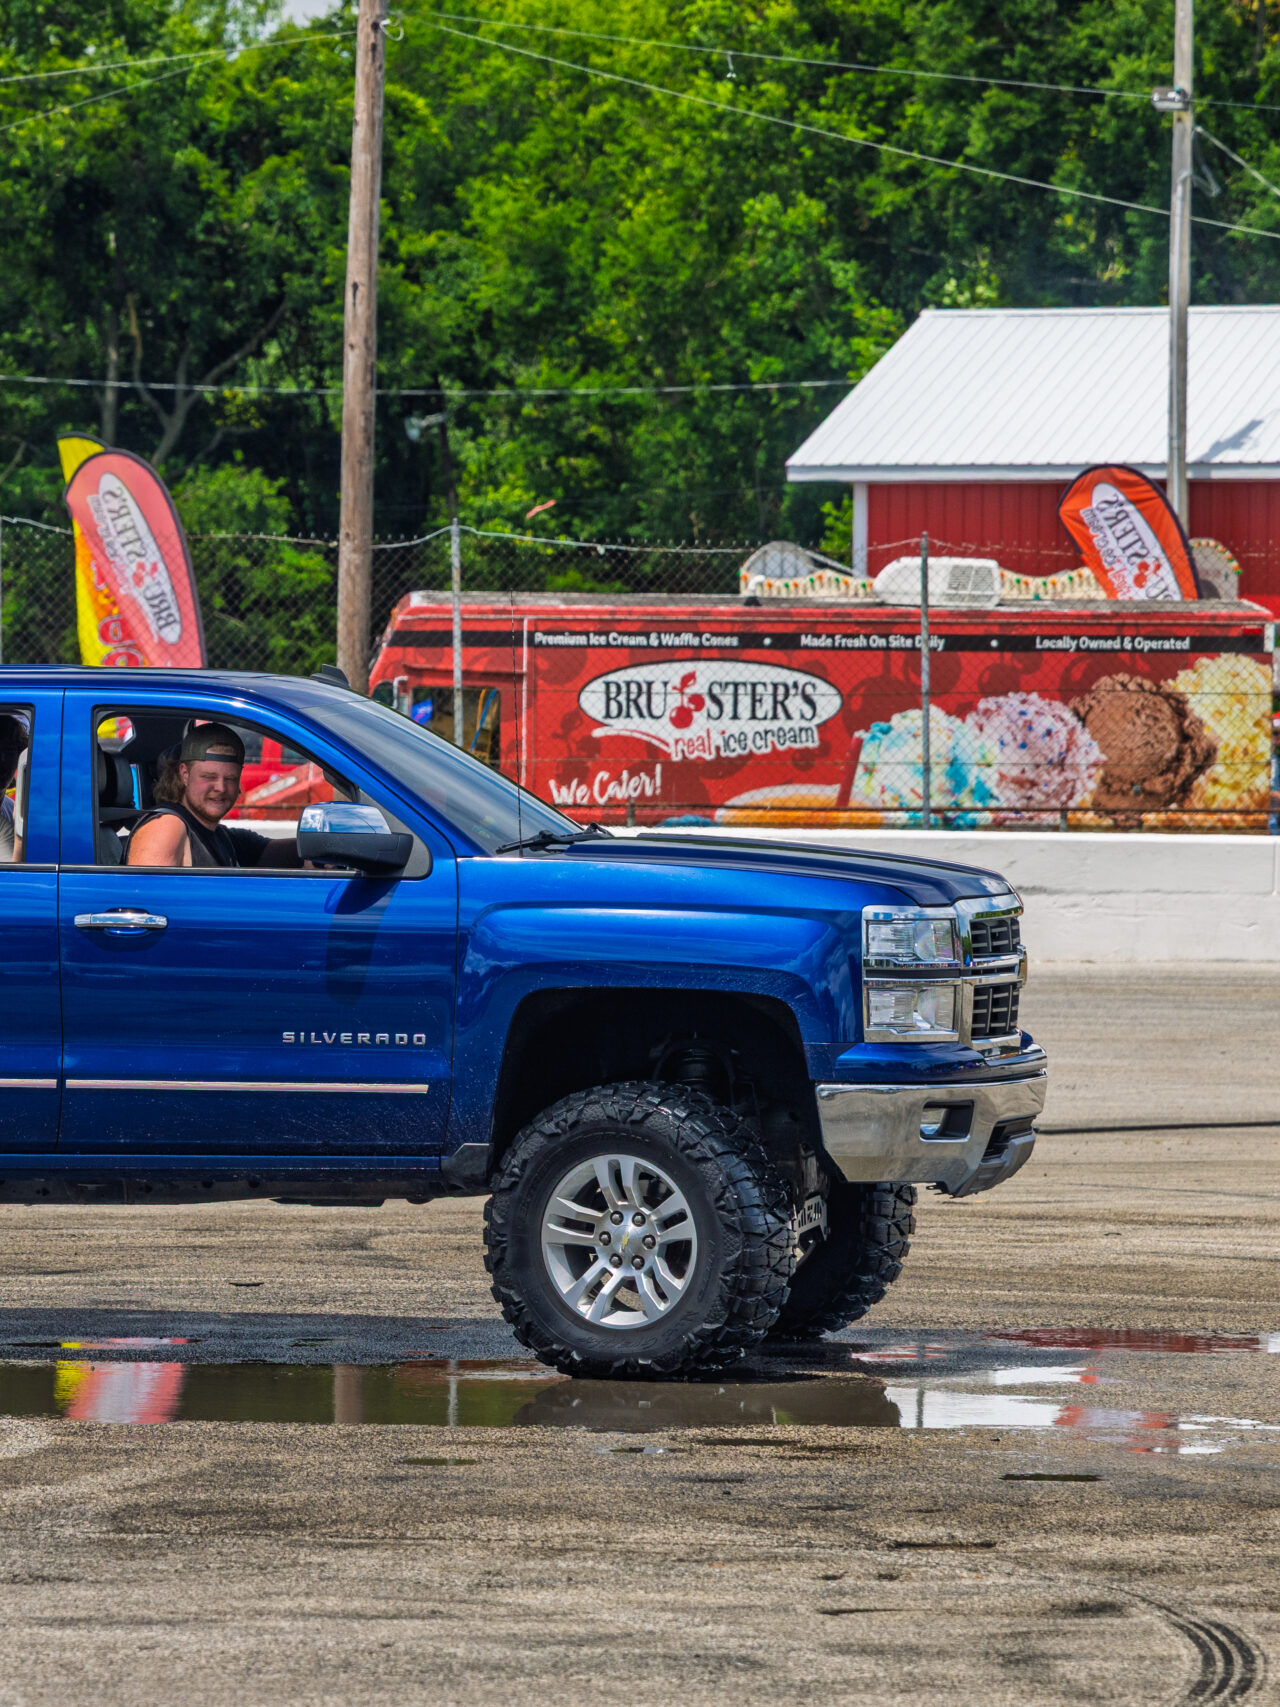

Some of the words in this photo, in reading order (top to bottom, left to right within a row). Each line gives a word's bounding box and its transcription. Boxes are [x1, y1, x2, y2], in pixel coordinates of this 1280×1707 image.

[534, 632, 587, 646] Premium
[589, 632, 607, 646] Ice
[608, 632, 647, 646] Cream
[649, 632, 659, 647] &
[661, 632, 699, 647] Waffle
[701, 633, 739, 647] Cones
[800, 634, 832, 648] Made
[834, 634, 867, 648] Fresh
[869, 634, 887, 648] On
[888, 634, 913, 648] Site
[914, 635, 945, 652] Dily
[1035, 635, 1077, 652] Locally
[1079, 636, 1121, 650] Owned
[1122, 636, 1132, 650] &
[1134, 636, 1190, 652] Operated
[674, 728, 712, 756] real
[721, 730, 748, 753] ice
[752, 726, 816, 750] cream
[548, 778, 590, 805] We
[592, 763, 662, 805] Cater!
[282, 1031, 426, 1045] SILVERADO
